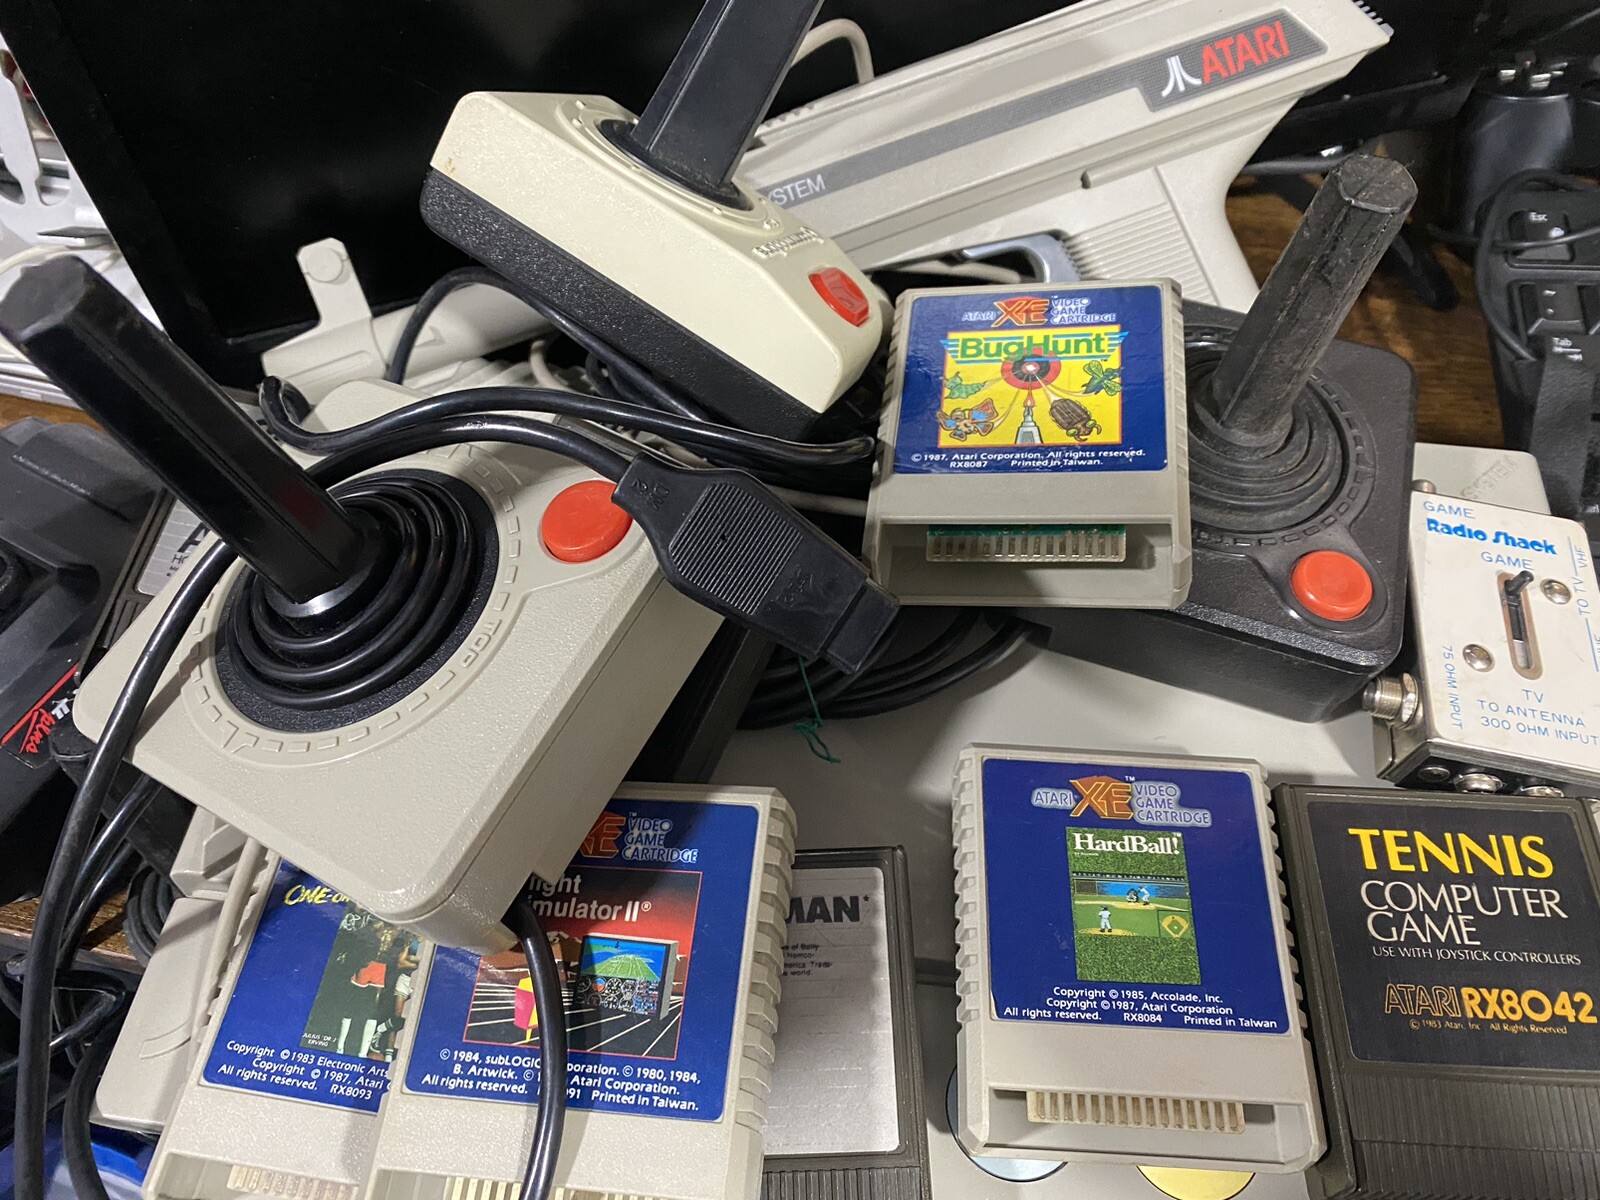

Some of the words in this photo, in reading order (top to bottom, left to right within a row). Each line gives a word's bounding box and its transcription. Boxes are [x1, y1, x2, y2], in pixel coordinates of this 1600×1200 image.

[1202, 20, 1290, 85] ATARI
[768, 174, 826, 206] STEM
[1051, 297, 1091, 307] VIDEO
[1051, 306, 1086, 315] GAME
[962, 310, 997, 322] ATARI
[991, 299, 1050, 328] XE
[1050, 313, 1116, 324] CARTRIDGE
[960, 333, 1107, 361] BugHunt
[949, 461, 988, 469] RX8087
[1011, 459, 1048, 467] Printed
[952, 453, 977, 461] Atari
[1047, 451, 1062, 459] All
[1065, 450, 1095, 459] rights
[1098, 449, 1146, 458] reserved.
[1423, 500, 1476, 519] GAME
[1426, 517, 1487, 542] Radio
[1492, 530, 1558, 555] Shack
[1480, 551, 1534, 570] GAME
[1574, 577, 1586, 594] TV
[1578, 598, 1591, 616] TO
[1445, 664, 1458, 690] OHM
[1522, 688, 1545, 703] TV
[1450, 693, 1464, 730] INPUT
[1477, 699, 1499, 713] TO
[1505, 706, 1586, 727] ANTENNA
[1480, 716, 1510, 731] 300
[1516, 722, 1550, 738] OHM
[1554, 730, 1599, 745] INPUT
[1034, 791, 1073, 806] ATARI
[1069, 779, 1134, 820] XE
[1134, 784, 1178, 797] VIDEO
[1136, 797, 1174, 809] GAME
[628, 818, 673, 832] VIDEO
[1137, 809, 1210, 824] CARTRIDGE
[625, 832, 666, 846] GAME
[1072, 833, 1180, 855] HardBall!
[622, 847, 698, 863] CARTRIDGE
[1348, 828, 1554, 878] TENNIS
[529, 872, 582, 897] light
[527, 894, 623, 921] mulator
[1360, 880, 1568, 918] COMPUTER
[1367, 911, 1481, 945] GAME
[1373, 946, 1395, 958] USE
[1399, 947, 1433, 959] WITH
[1437, 948, 1492, 961] JOYSTICK
[1493, 950, 1582, 966] CONTROLLERS
[1053, 986, 1106, 999] Copyright
[1150, 991, 1202, 1003] Accolade,
[1205, 993, 1223, 1003] Inc.
[1384, 983, 1462, 1018] ATARI
[1461, 986, 1599, 1025] RX8042
[1046, 997, 1097, 1010] Copyright
[1141, 1003, 1168, 1012] Atari
[1170, 1004, 1233, 1015] Corporation
[1004, 1007, 1018, 1016] All
[1022, 1008, 1052, 1019] rights
[1055, 1011, 1102, 1020] reserved.
[1123, 1013, 1162, 1023] RX8084
[1184, 1015, 1221, 1026] Printed
[1225, 1017, 1236, 1026] in
[1238, 1018, 1277, 1028] Taiwan
[1489, 1023, 1501, 1031] All
[226, 1040, 275, 1058] Copyright
[317, 1056, 366, 1073] Electronic
[453, 1050, 482, 1064] 1984,
[567, 1062, 620, 1076] poration.
[637, 1067, 667, 1081] 1980,
[670, 1070, 701, 1084] 1984,
[217, 1064, 234, 1075] All
[236, 1067, 267, 1081] rights
[270, 1074, 318, 1091] reserved.
[330, 1084, 372, 1100] RX8093
[252, 1058, 305, 1075] Copyright
[324, 1070, 351, 1084] 1987,
[355, 1076, 384, 1089] Atari
[453, 1064, 464, 1075] B.
[467, 1065, 518, 1080] Artwick.
[570, 1075, 601, 1087] Atari
[605, 1077, 680, 1095] Corporation.
[421, 1073, 439, 1086] All
[440, 1076, 474, 1089] rights
[476, 1079, 528, 1095] reserved.
[591, 1090, 636, 1105] Printed
[638, 1095, 649, 1106] in
[652, 1096, 699, 1111] Taiwan.
